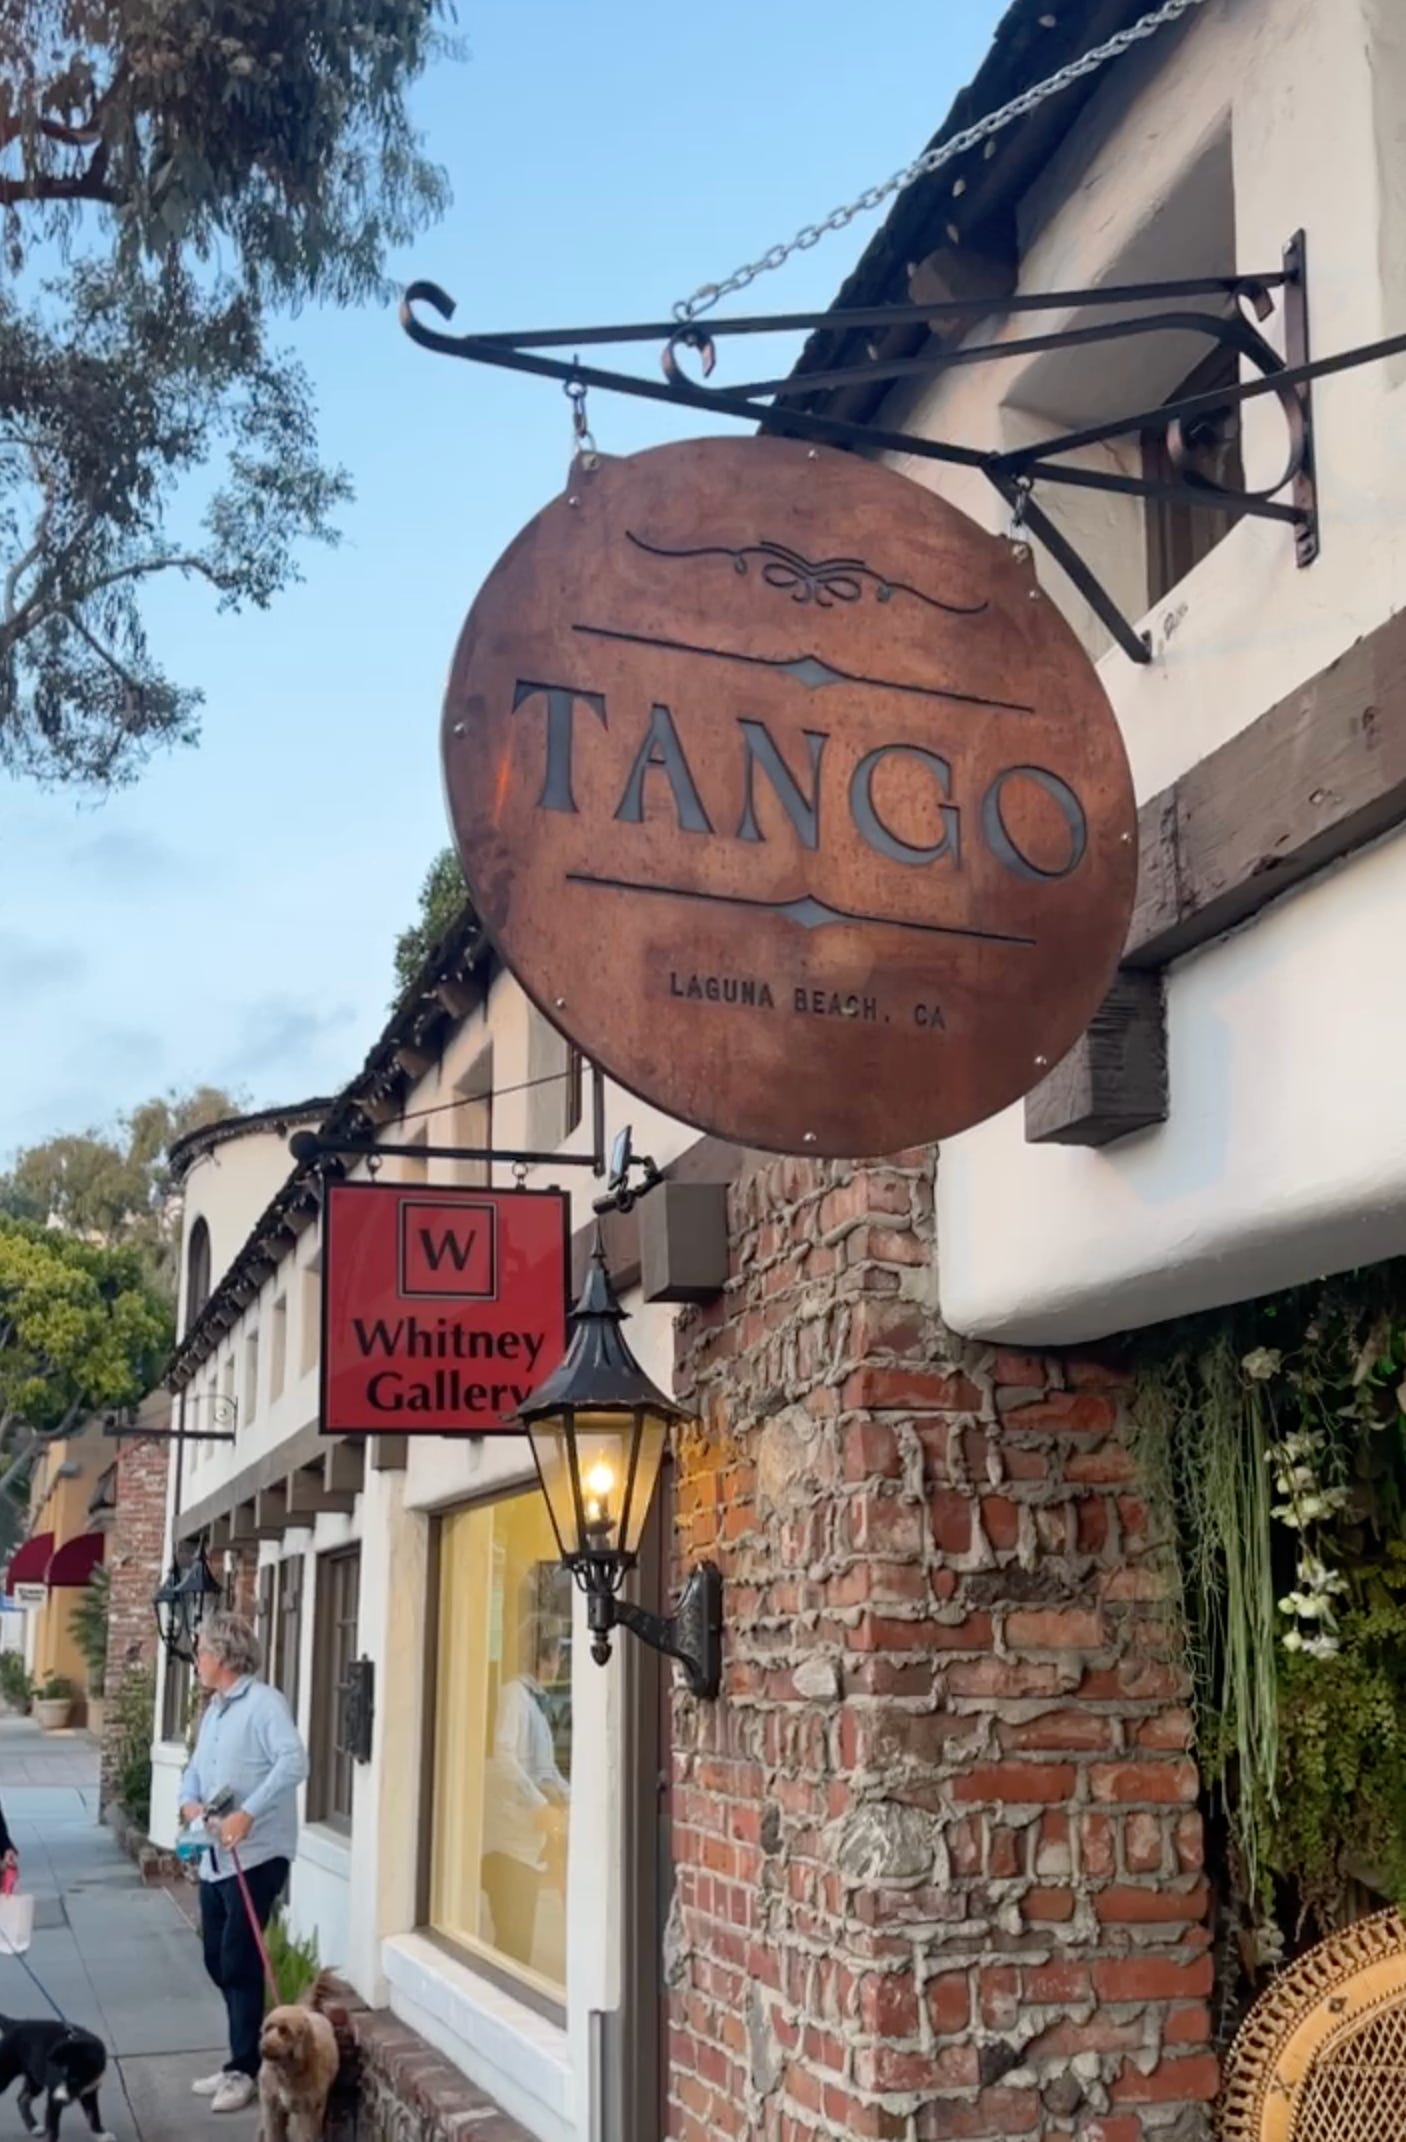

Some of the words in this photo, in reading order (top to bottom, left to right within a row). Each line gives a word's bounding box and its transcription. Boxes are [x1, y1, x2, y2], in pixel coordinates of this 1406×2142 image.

[512, 680, 1087, 881] TANGO
[669, 972, 774, 1009] LAGUNA
[914, 1003, 945, 1030] CA
[419, 1228, 476, 1271] W
[354, 1317, 545, 1372] Whitney
[367, 1370, 533, 1411] Gallery
